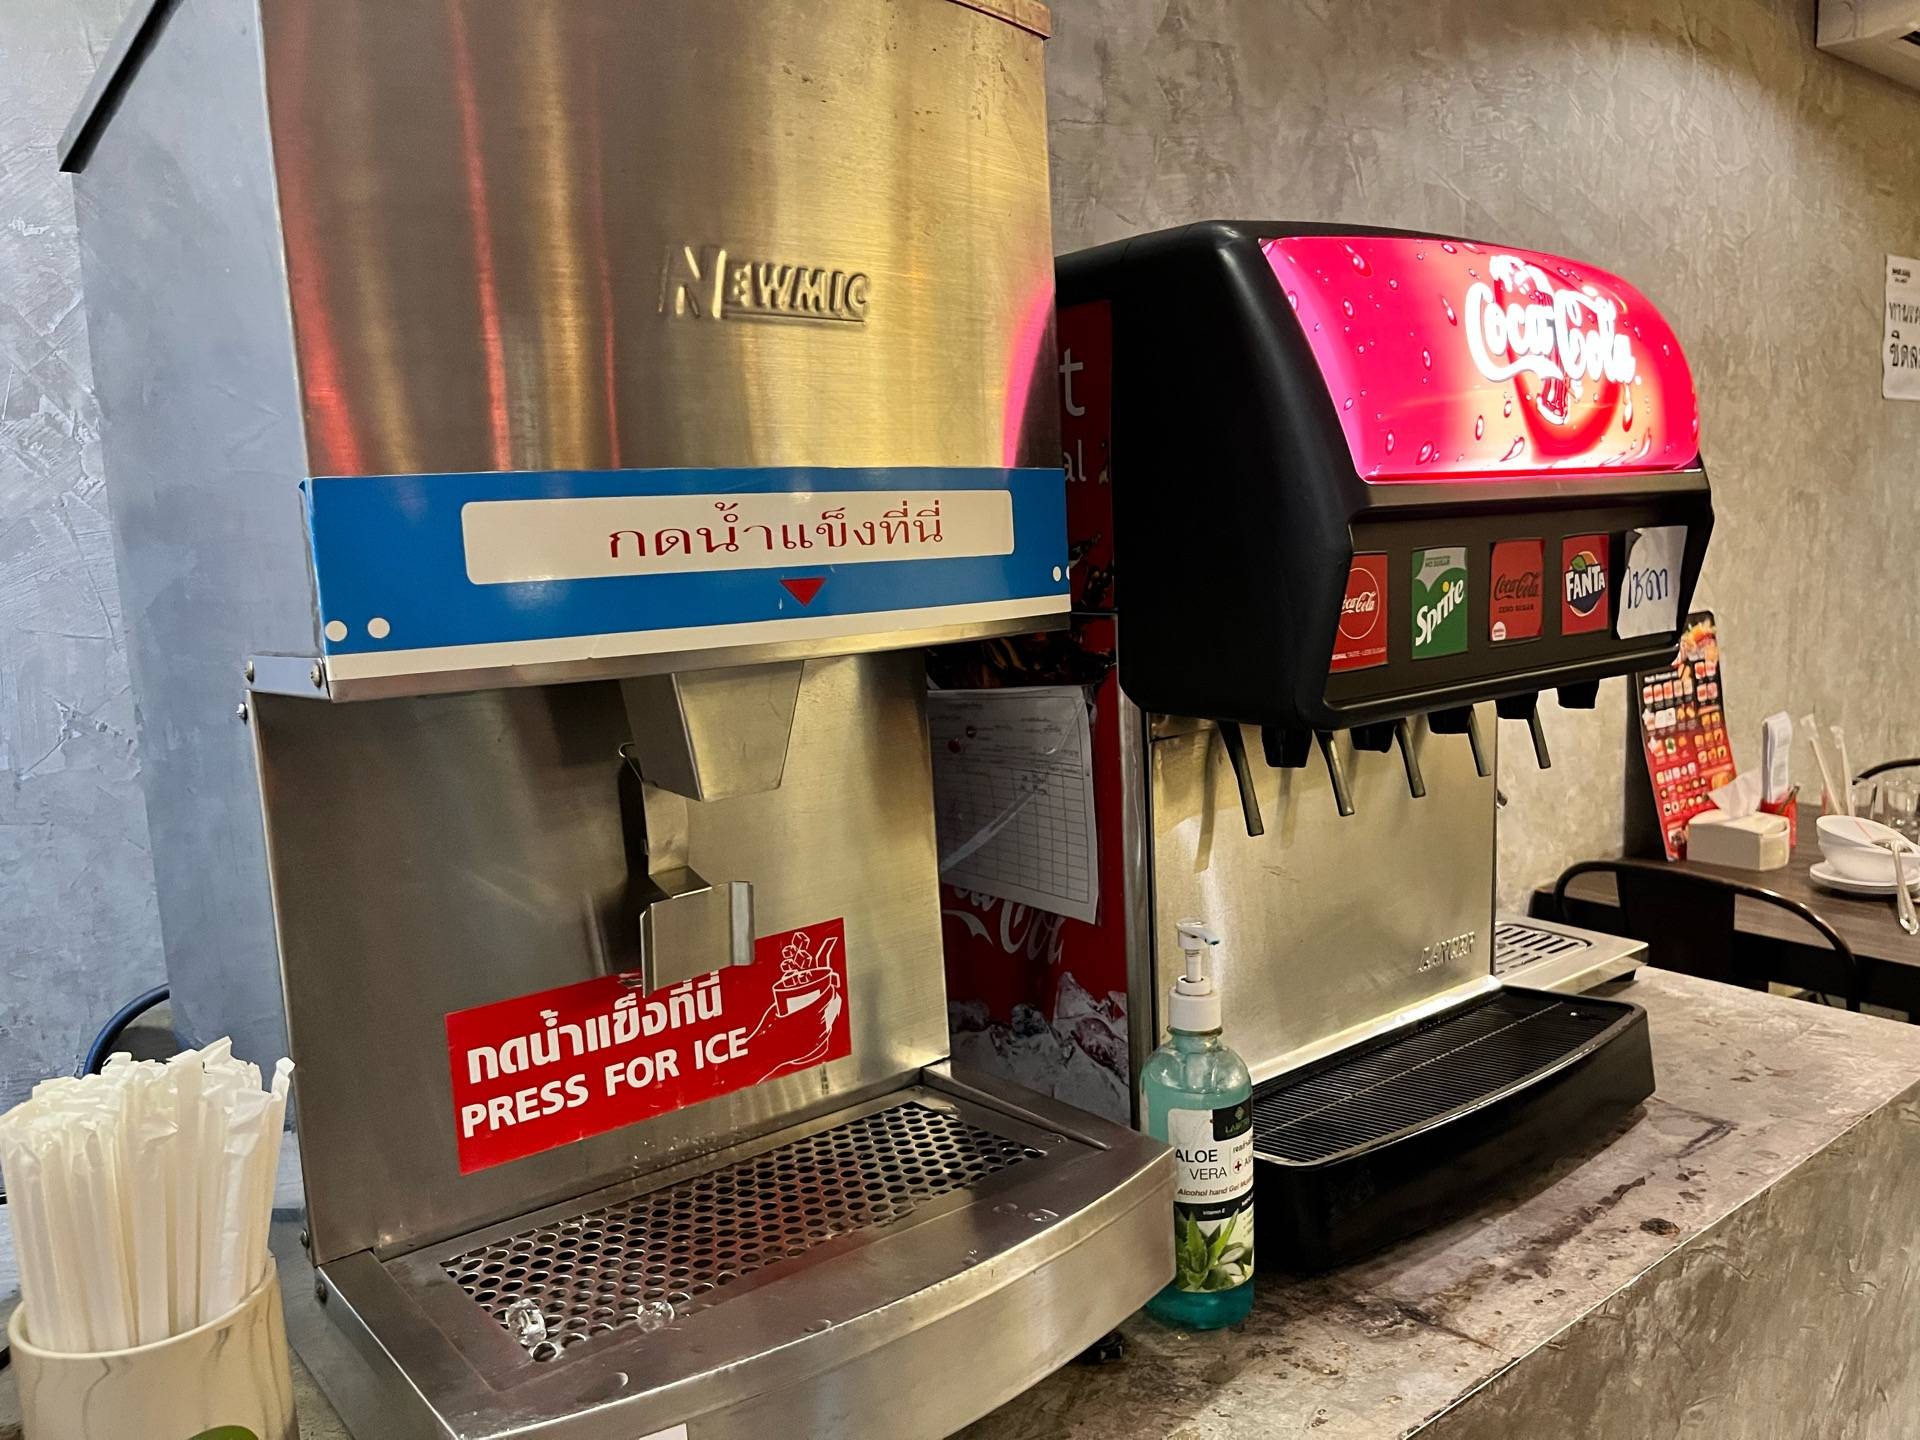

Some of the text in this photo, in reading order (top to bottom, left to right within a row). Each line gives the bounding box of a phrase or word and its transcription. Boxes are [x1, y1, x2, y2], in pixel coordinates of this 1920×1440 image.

[658, 246, 869, 320] NEWMIC
[609, 500, 943, 558] กดน้ำแข็งที่นี่
[1565, 565, 1606, 601] FANTA
[1415, 579, 1464, 646] Sprite
[461, 1026, 749, 1138] PRESS FOR ICE
[1175, 1149, 1218, 1163] ALOE
[1189, 1166, 1227, 1180] VERA
[1177, 1187, 1208, 1197] Alcohol
[1209, 1186, 1228, 1196] hand
